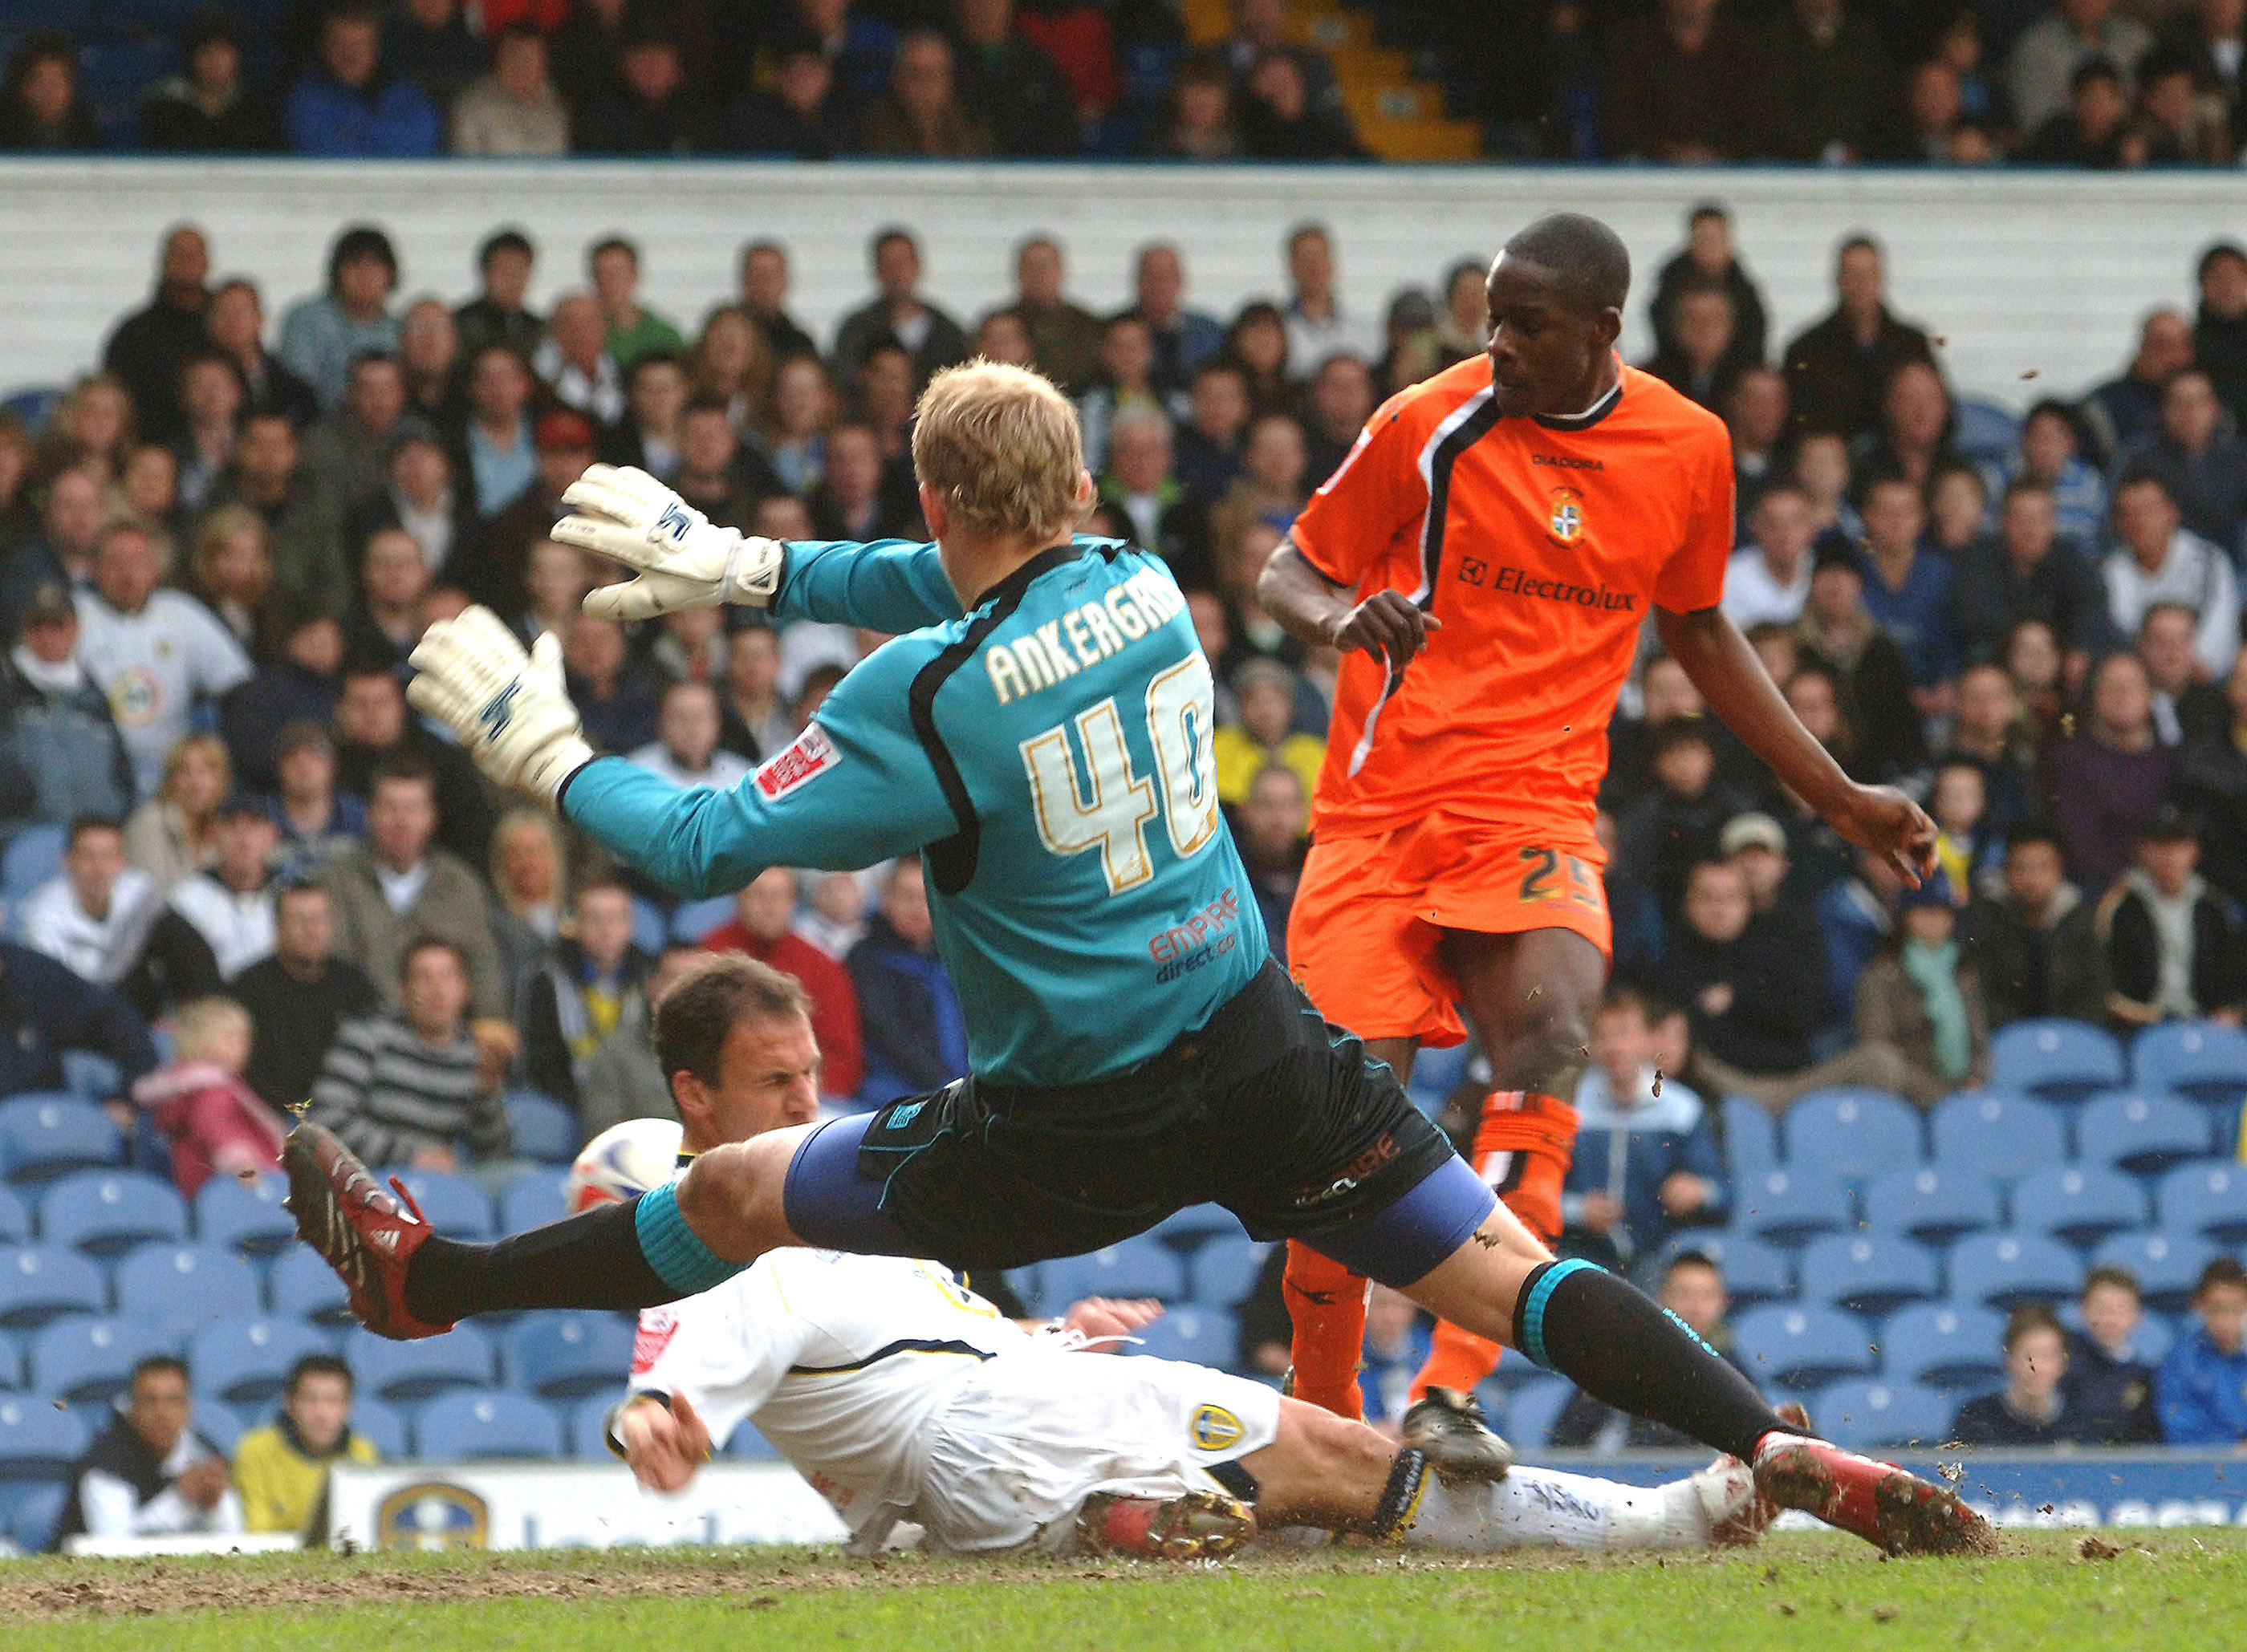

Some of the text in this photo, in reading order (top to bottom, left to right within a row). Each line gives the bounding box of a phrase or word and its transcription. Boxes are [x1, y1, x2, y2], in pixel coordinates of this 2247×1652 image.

[1533, 454, 1603, 470] DIADORA
[1494, 566, 1637, 611] Electrolux
[1018, 650, 1218, 896] 40
